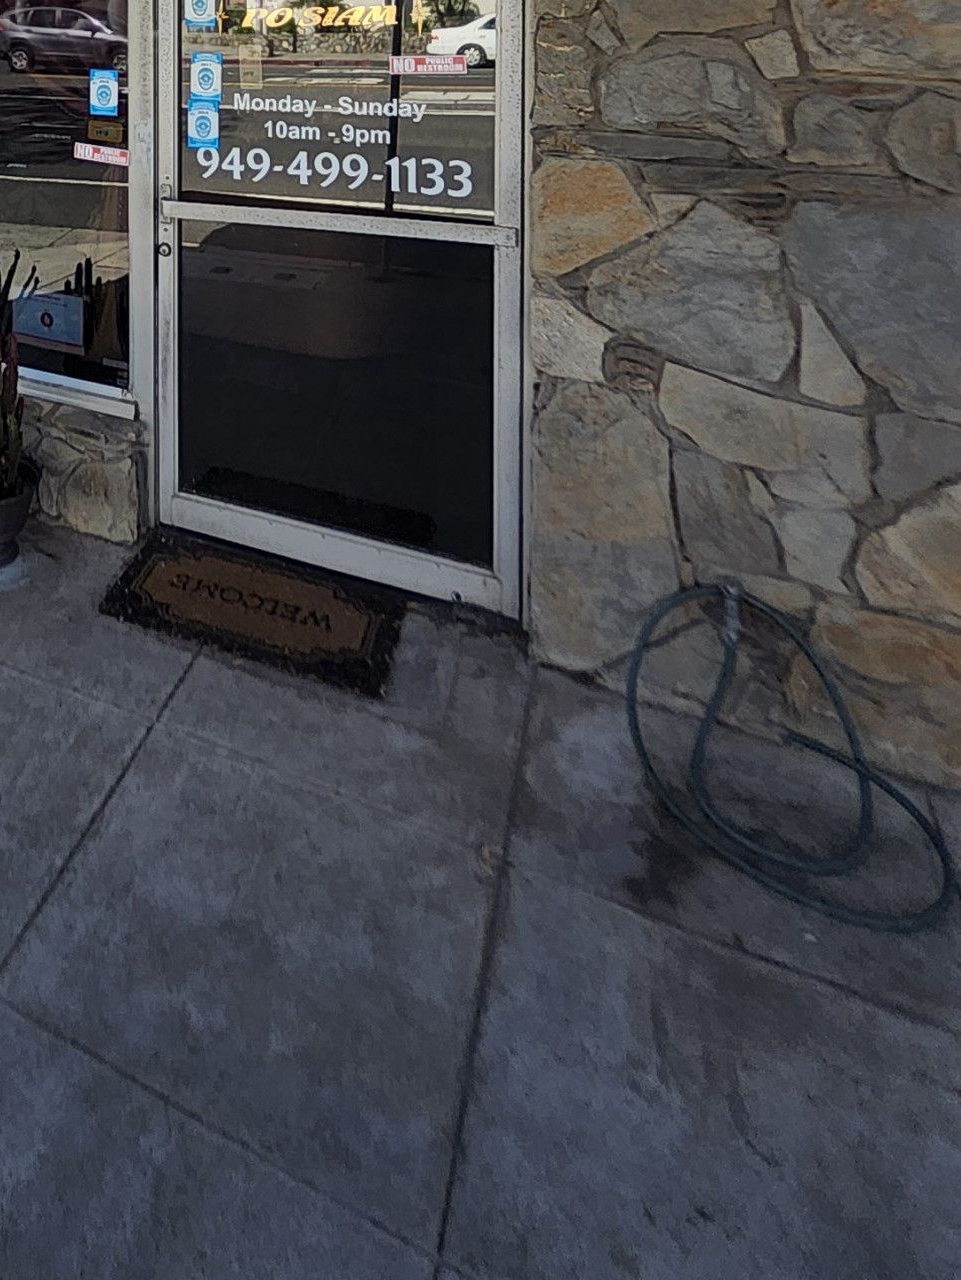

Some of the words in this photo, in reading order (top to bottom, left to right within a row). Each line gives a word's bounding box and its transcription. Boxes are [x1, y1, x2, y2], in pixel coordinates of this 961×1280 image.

[241, 5, 292, 28] PO
[298, 4, 399, 28] SIAM
[393, 58, 416, 72] NO
[234, 93, 317, 117] Monday
[338, 96, 427, 123] Sunday
[264, 120, 320, 141] 10am
[341, 124, 392, 148] 9pm
[196, 146, 473, 198] 949-499-1133
[171, 575, 330, 629] WELCOME
